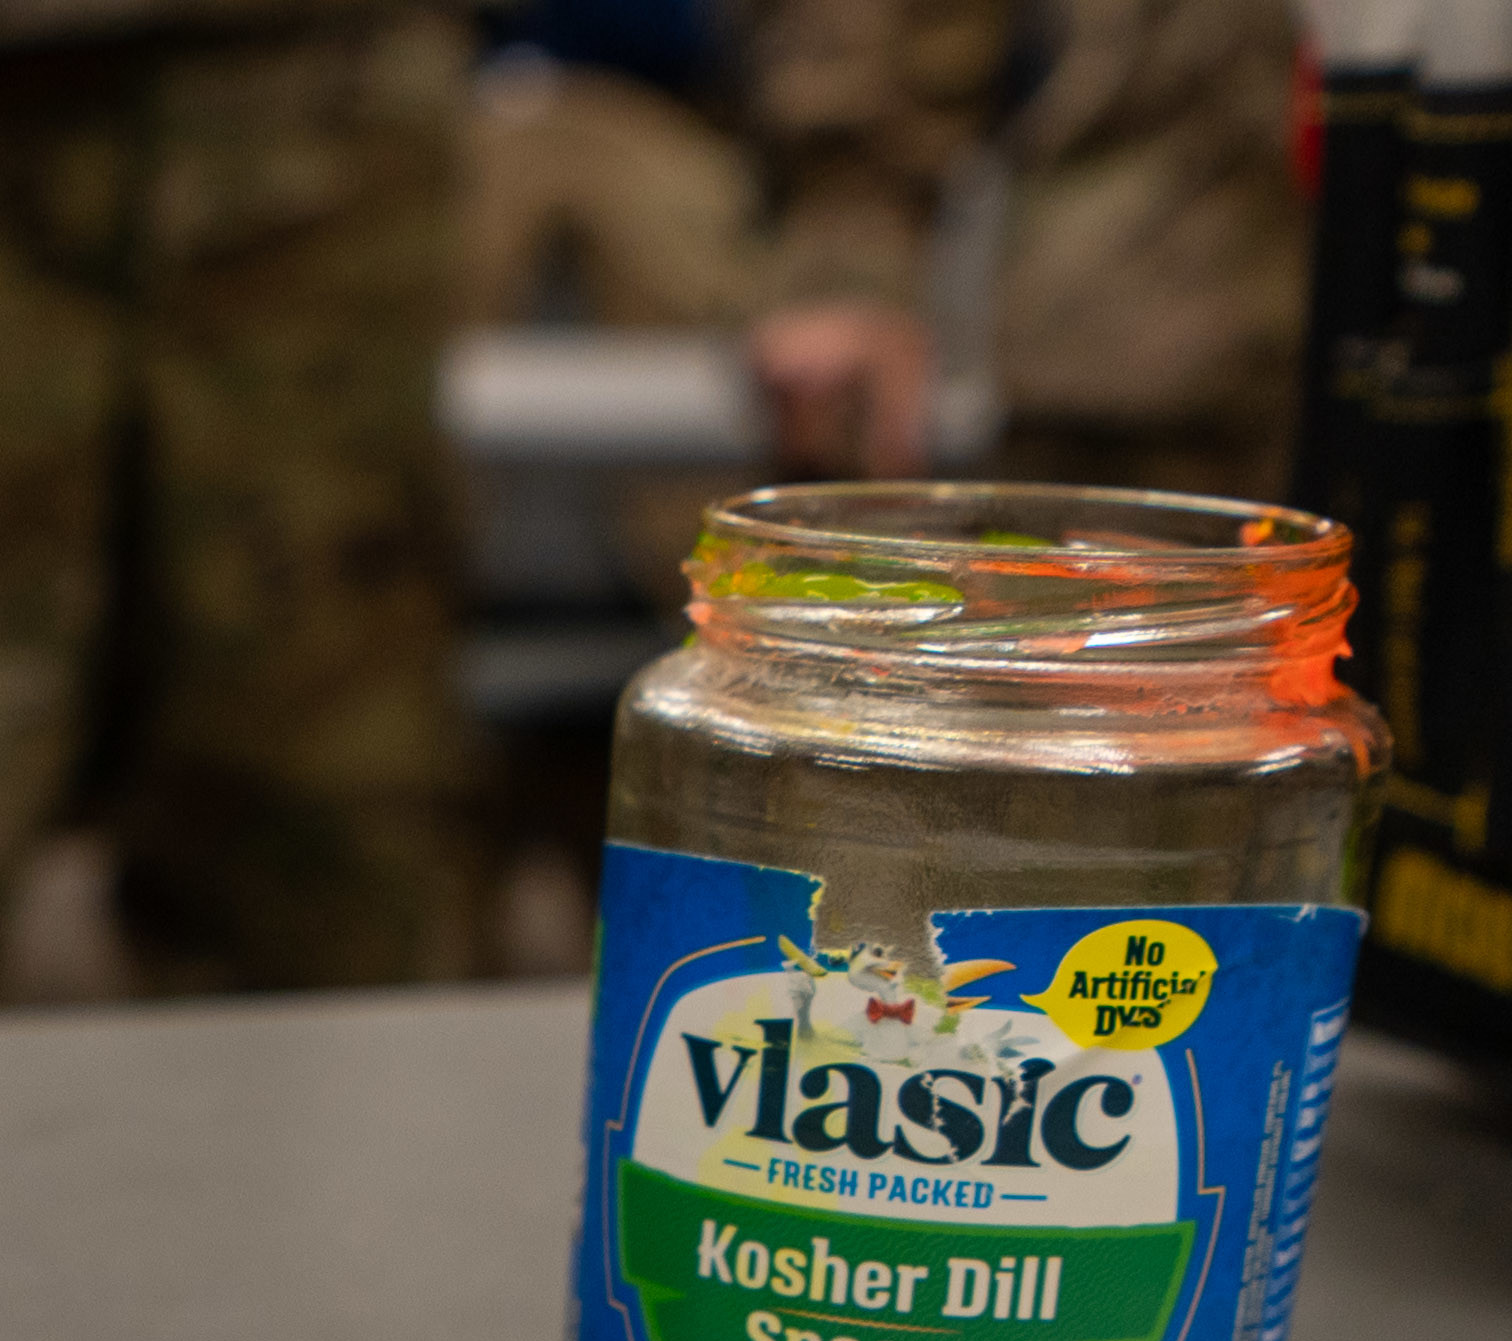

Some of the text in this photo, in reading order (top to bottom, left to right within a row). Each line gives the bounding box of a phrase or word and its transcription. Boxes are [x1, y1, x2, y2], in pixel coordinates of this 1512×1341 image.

[1125, 936, 1165, 966] No
[681, 1018, 1136, 1171] vlasic
[767, 1158, 994, 1210] FRESH PACKED
[697, 1219, 1063, 1321] Kosher Dill
